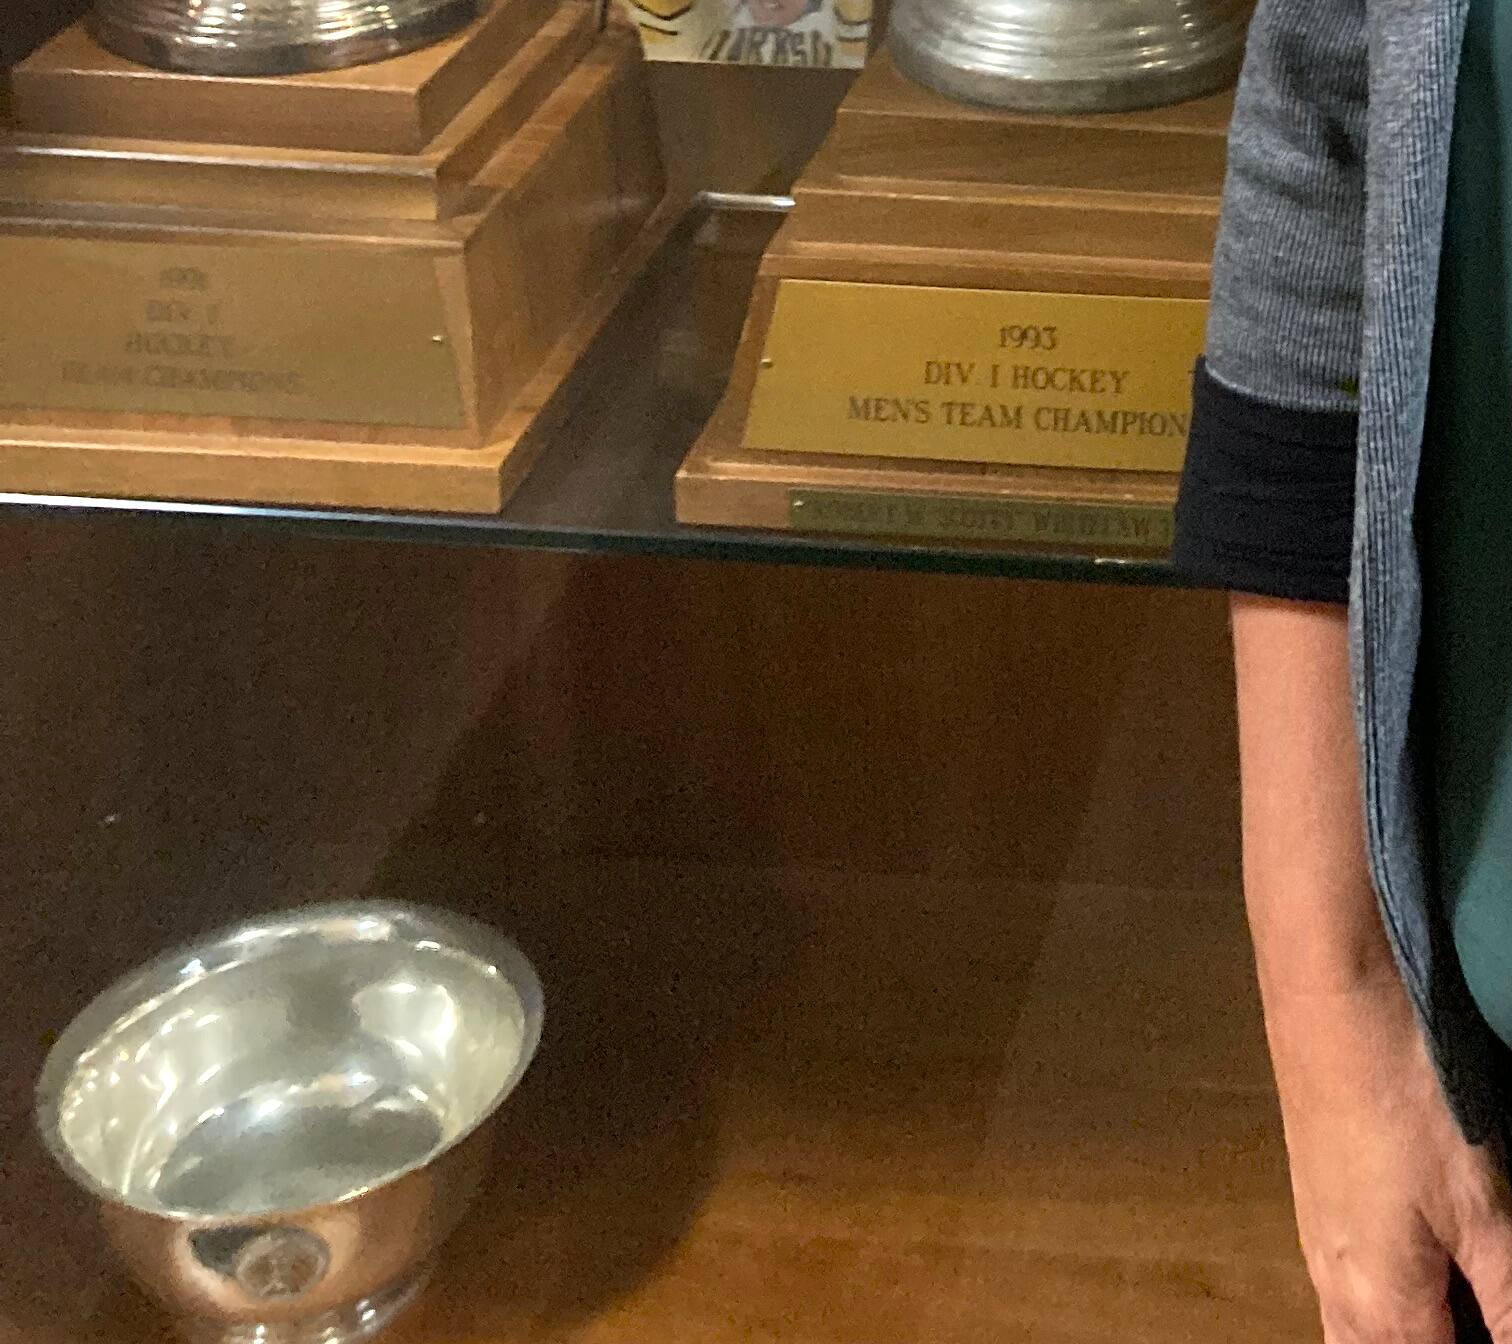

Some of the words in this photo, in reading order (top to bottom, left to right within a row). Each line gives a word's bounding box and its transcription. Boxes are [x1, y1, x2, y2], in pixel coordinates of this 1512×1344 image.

[1000, 325, 1057, 351] 1993
[990, 363, 1001, 388] I
[1011, 367, 1131, 395] HOCKEY
[940, 401, 1024, 430] TEAM
